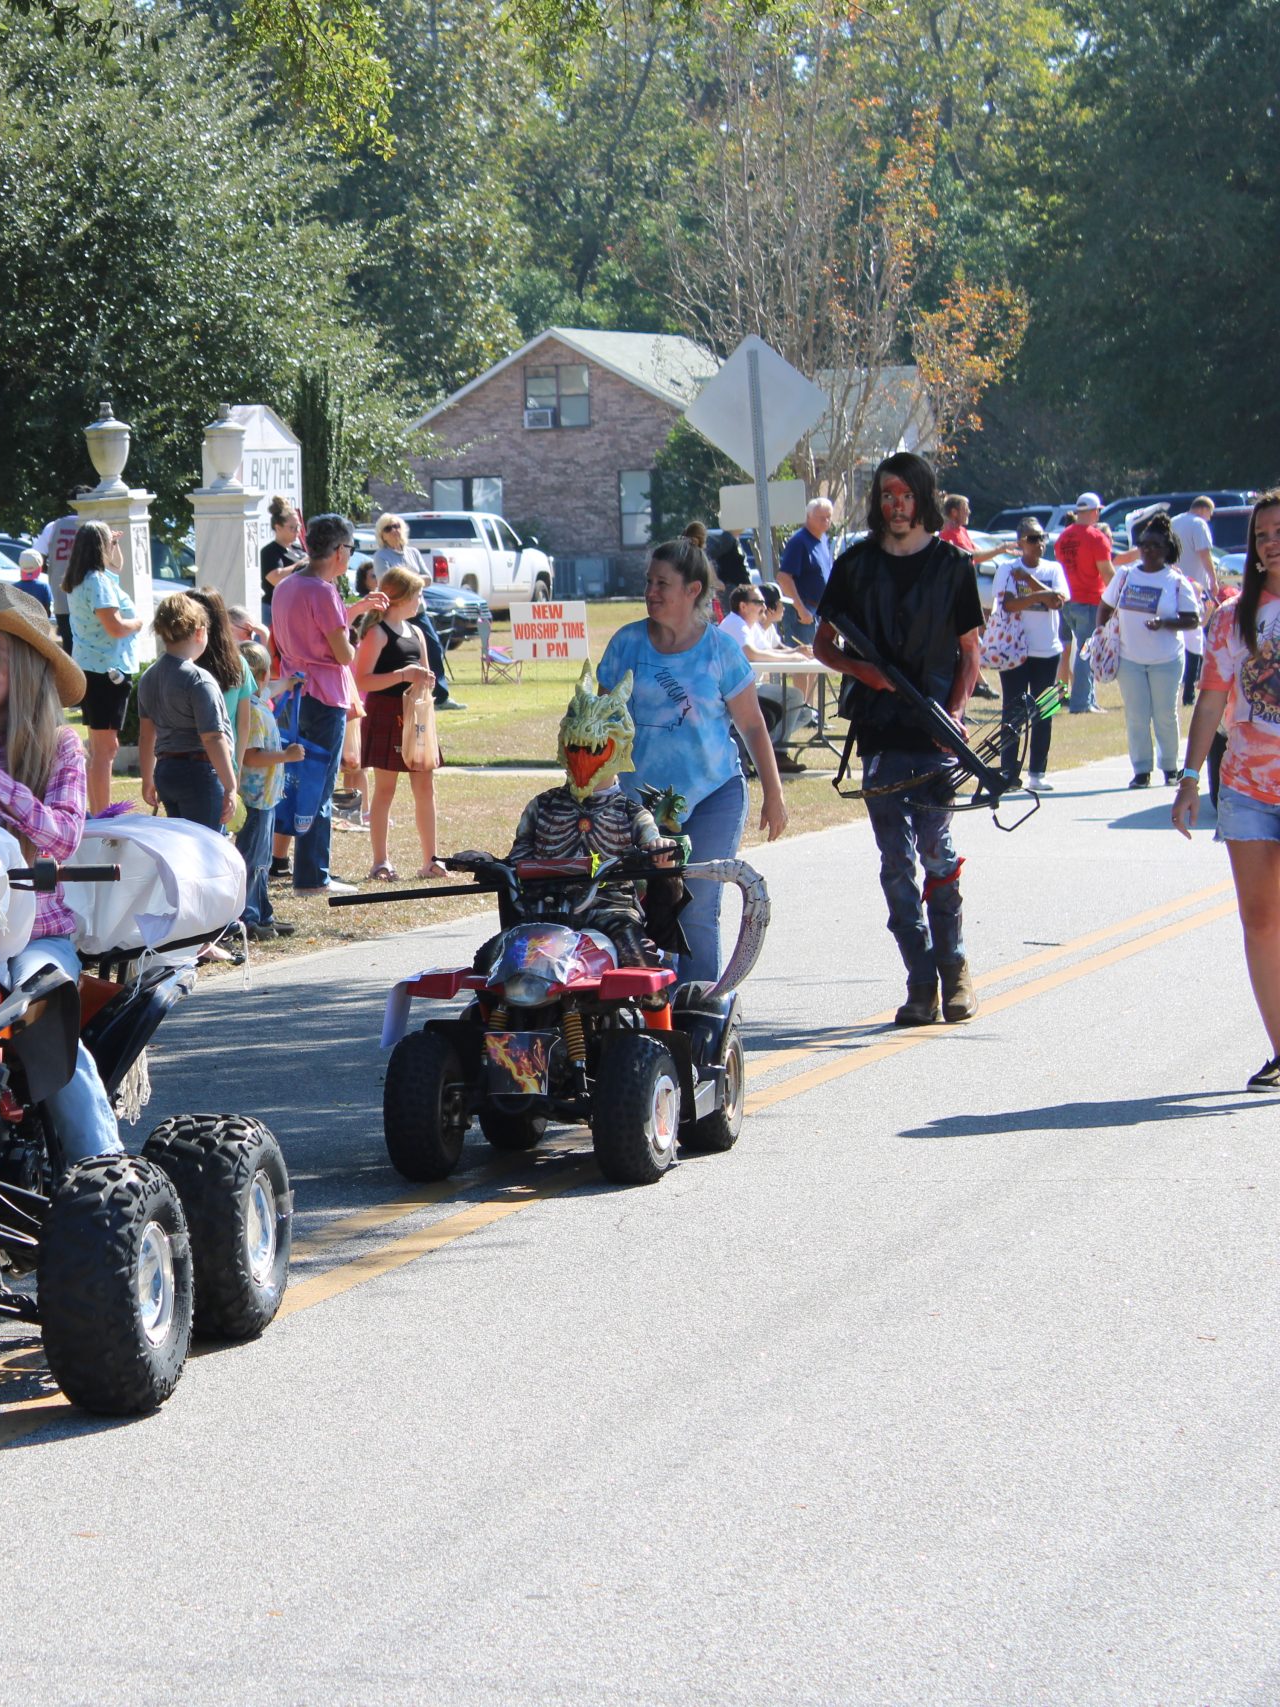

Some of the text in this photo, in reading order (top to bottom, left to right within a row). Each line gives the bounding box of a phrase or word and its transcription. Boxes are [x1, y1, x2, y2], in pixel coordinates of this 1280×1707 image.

[251, 458, 295, 490] BLYTHE
[532, 605, 563, 619] NEW
[513, 622, 585, 640] WORSHIP TIME
[547, 642, 568, 657] PM
[654, 671, 688, 705] GEORGIA
